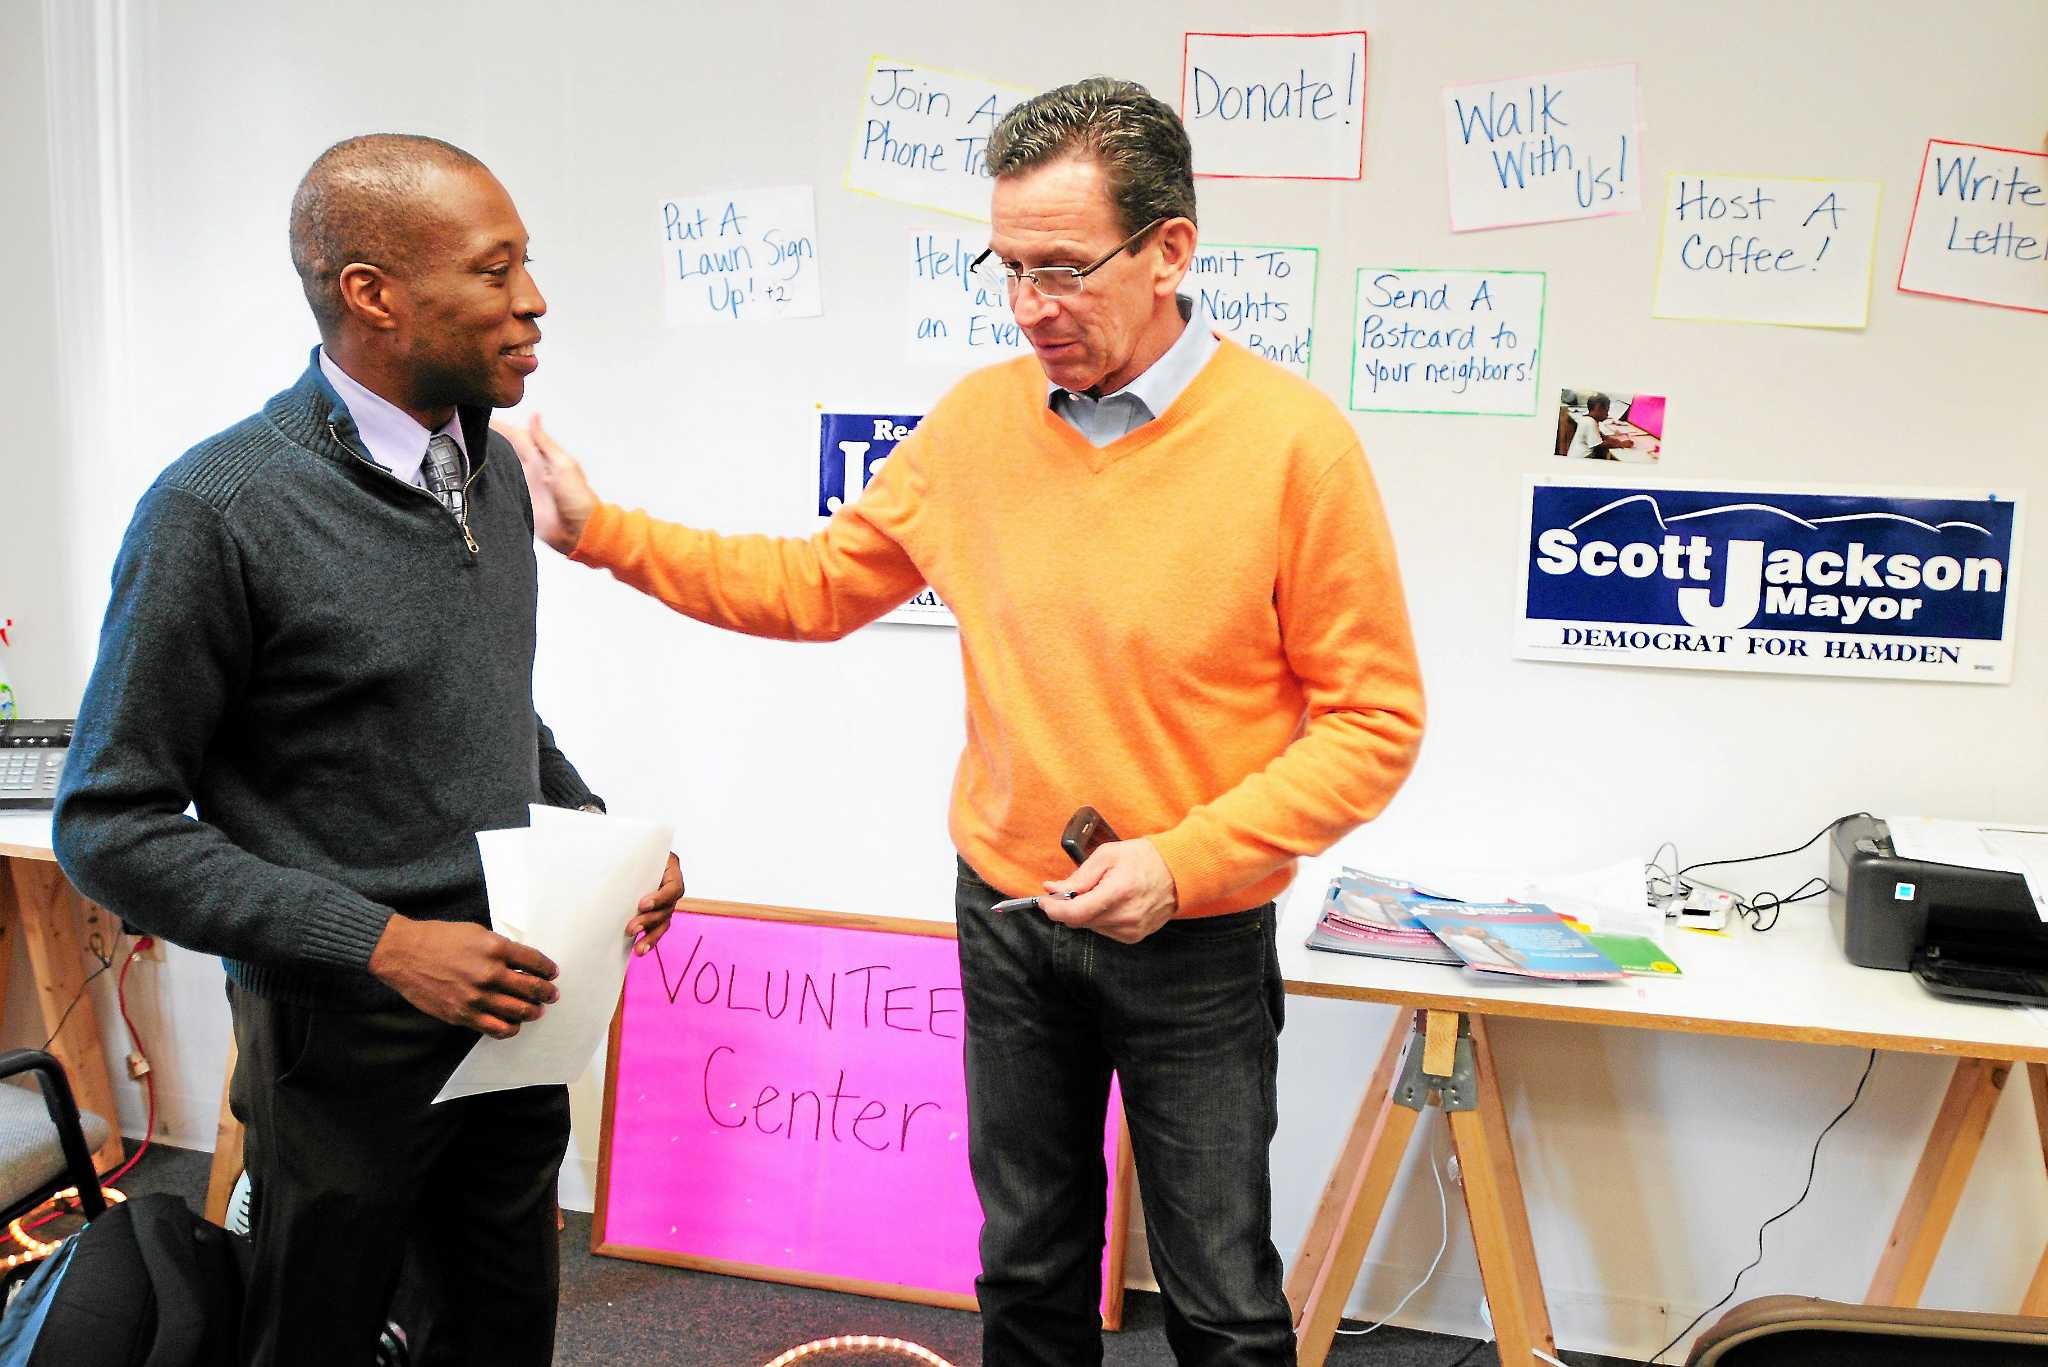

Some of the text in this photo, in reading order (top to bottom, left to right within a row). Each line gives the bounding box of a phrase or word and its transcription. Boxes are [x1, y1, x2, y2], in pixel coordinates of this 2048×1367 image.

[871, 69, 1003, 131] Join A
[1193, 53, 1356, 125] Donate!
[1455, 84, 1567, 144] Walk
[864, 120, 948, 171] Phone
[1493, 135, 1573, 188] With
[1577, 135, 1627, 208] Us!
[1937, 156, 2046, 206] Write
[665, 202, 748, 241] Put A
[1676, 180, 1847, 229] Host A
[679, 229, 812, 281] Lawn Sign
[915, 235, 977, 291] Help
[1256, 252, 1291, 278] To
[1681, 234, 1831, 274] Coffee!
[709, 277, 755, 319] Up!
[1200, 288, 1288, 331] Nights
[1366, 274, 1494, 310] Send A
[917, 317, 947, 339] an
[1362, 314, 1517, 350] Postcard to
[1425, 349, 1537, 393] neighbors!
[1537, 529, 2002, 630] Scott Jackson
[1765, 586, 1922, 624] Mayor
[1562, 627, 1961, 664] DEMOCRAT FOR HAMDEN
[704, 1046, 941, 1151] Center
